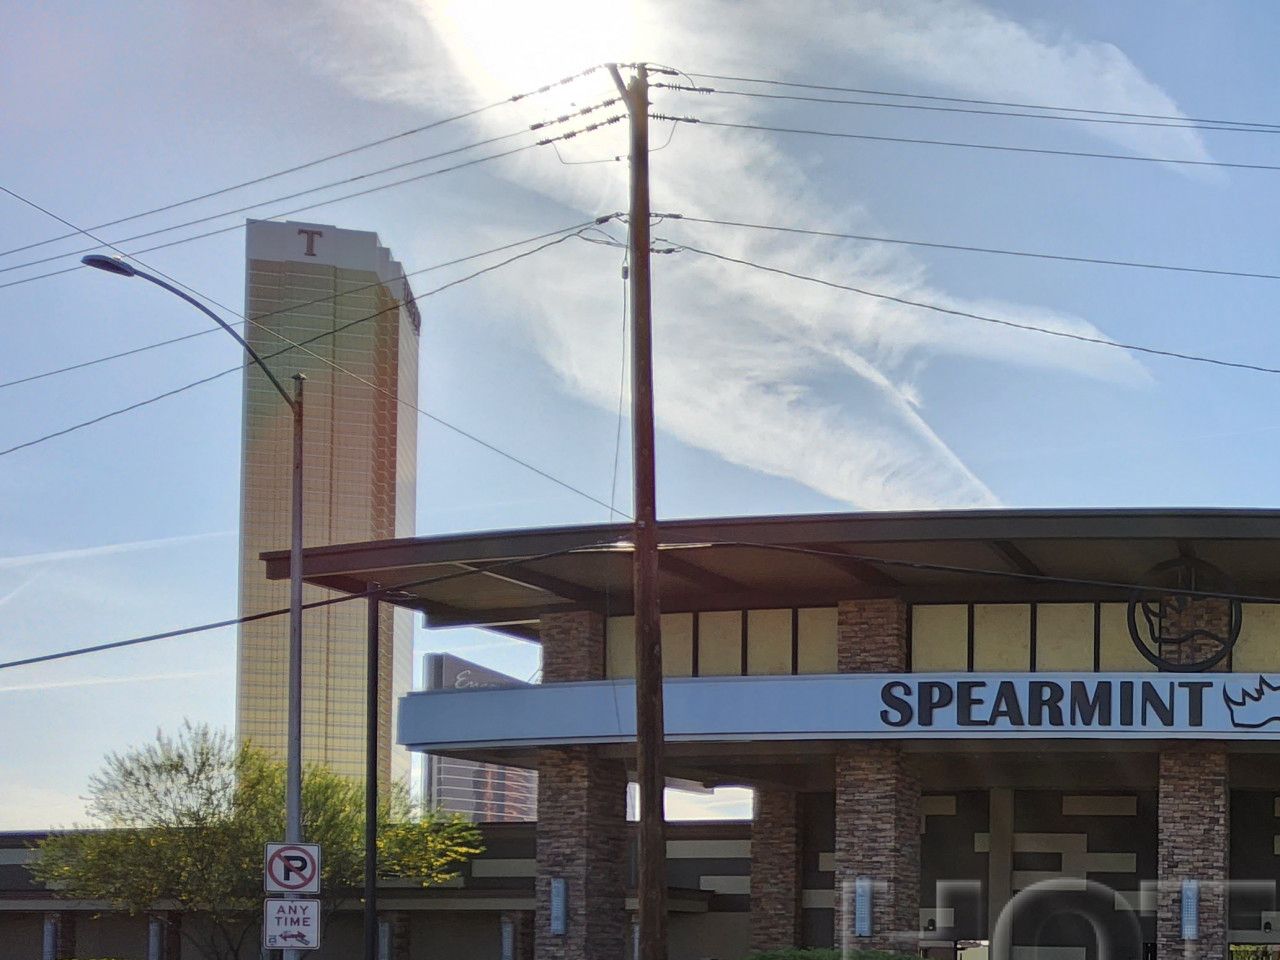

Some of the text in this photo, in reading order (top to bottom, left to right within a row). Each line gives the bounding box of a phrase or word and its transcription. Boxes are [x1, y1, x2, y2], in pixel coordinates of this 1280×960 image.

[298, 229, 323, 256] T
[880, 680, 1214, 727] SPEARMINT
[276, 905, 309, 916] ANY
[274, 917, 311, 927] TIME
